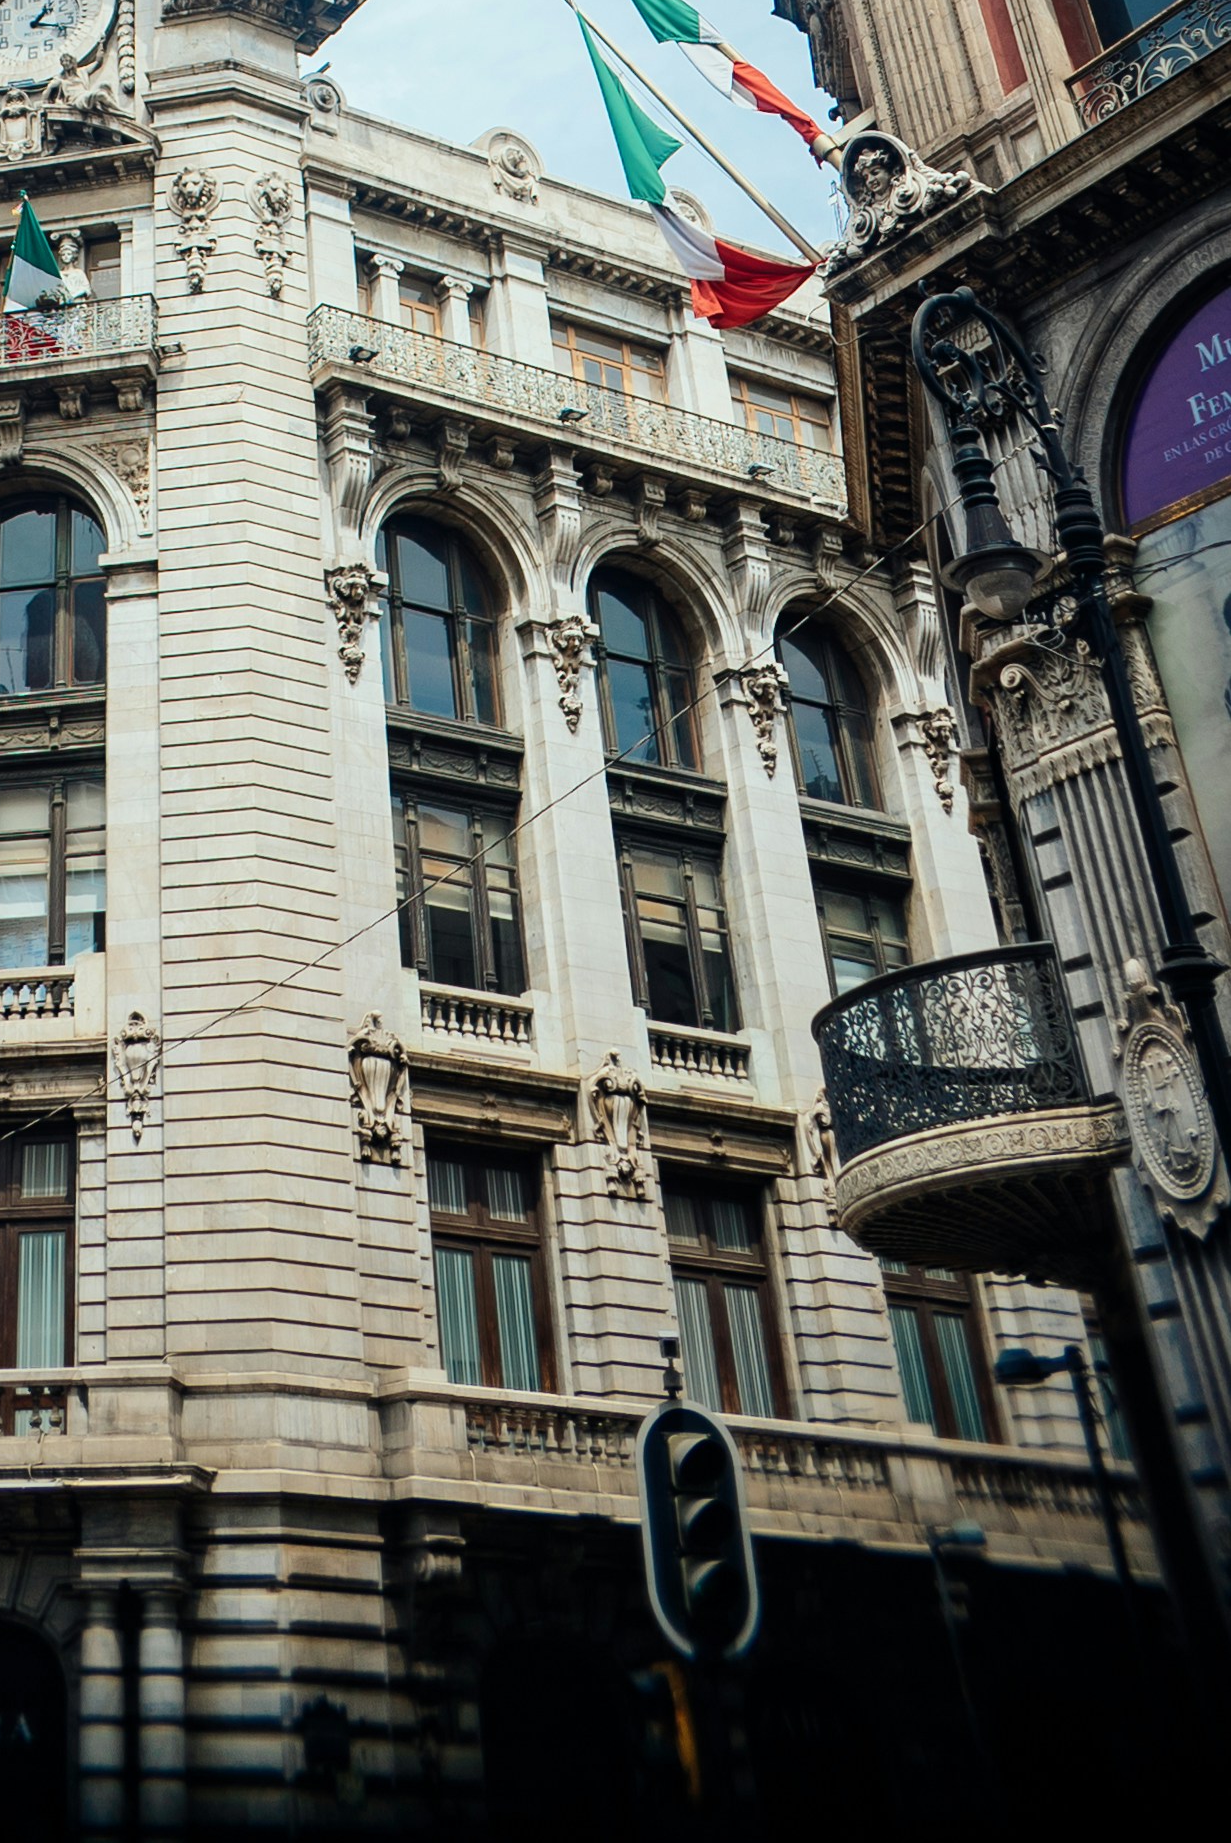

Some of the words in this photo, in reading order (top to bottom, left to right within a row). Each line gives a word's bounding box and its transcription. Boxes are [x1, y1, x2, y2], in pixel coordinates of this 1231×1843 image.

[58, 0, 68, 12] 2
[0, 8, 11, 22] 10
[63, 12, 74, 25] 3
[0, 36, 9, 49] 8
[44, 39, 54, 52] 5
[13, 44, 23, 57] 7
[28, 46, 38, 60] 6
[1163, 445, 1182, 462] EN
[1182, 432, 1207, 452] LAS
[1204, 446, 1224, 464] DE
